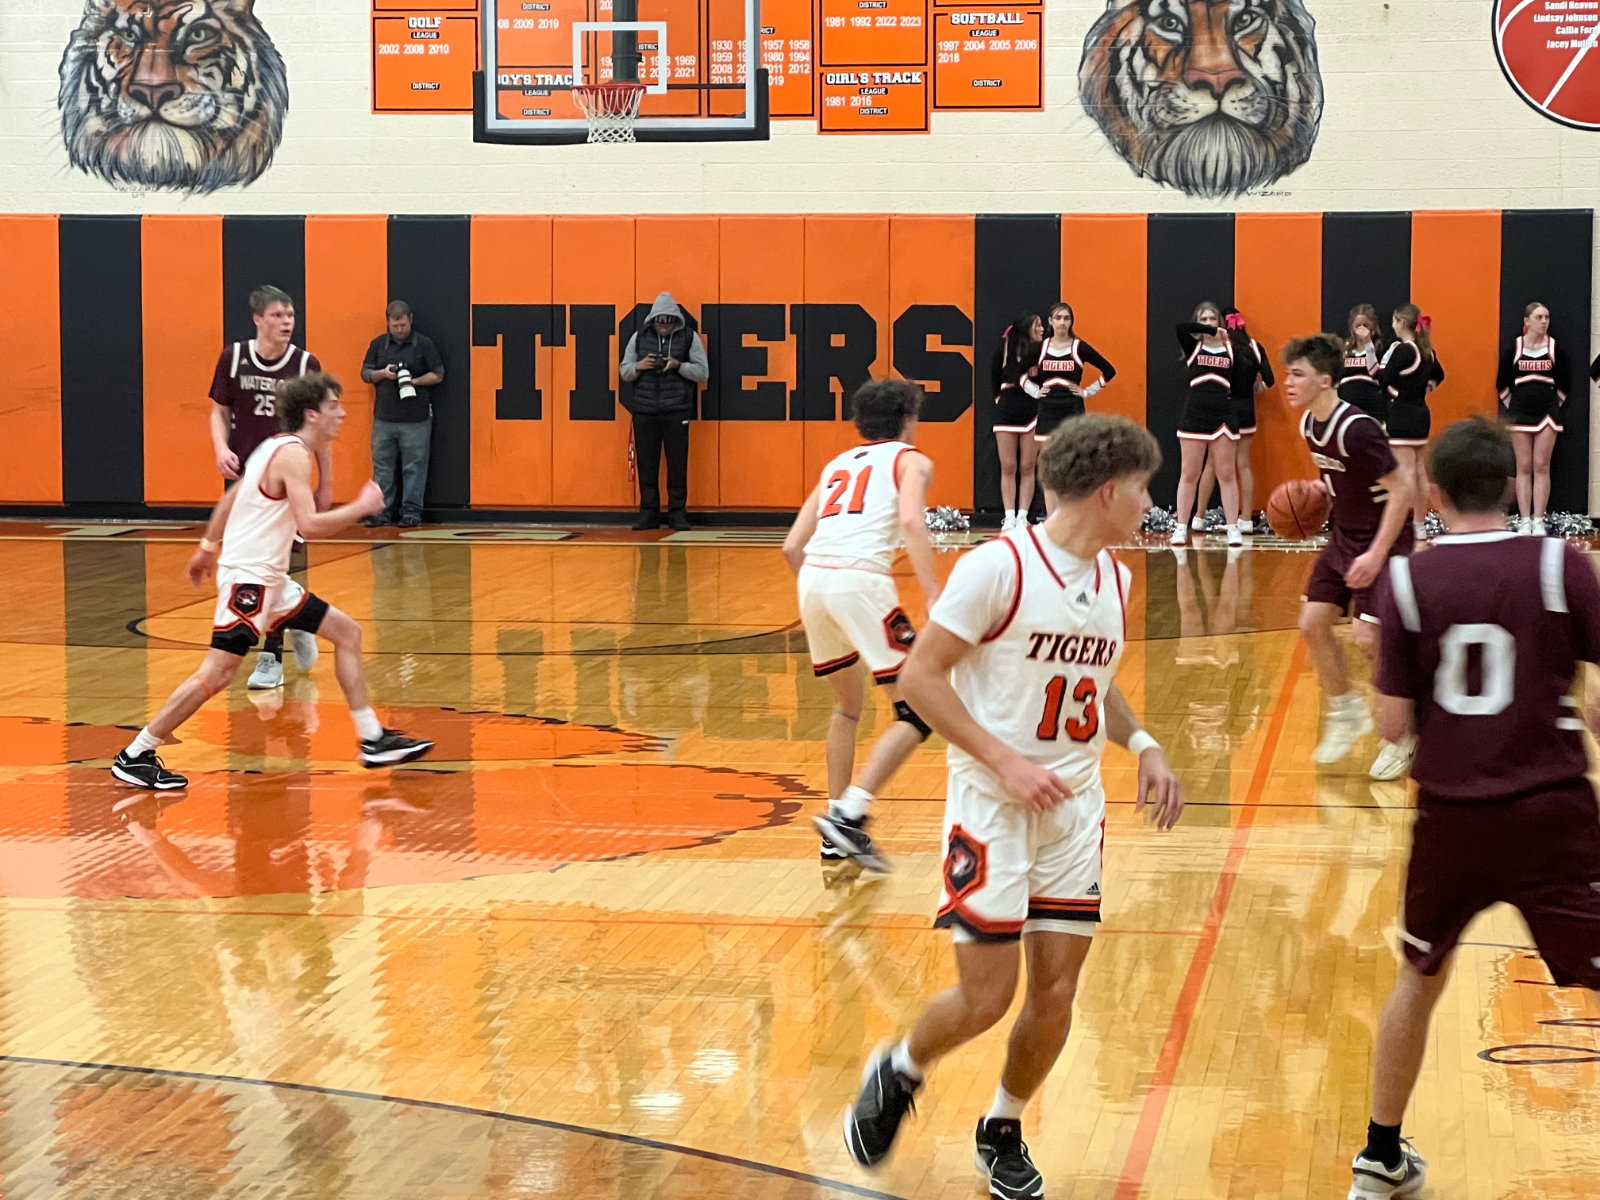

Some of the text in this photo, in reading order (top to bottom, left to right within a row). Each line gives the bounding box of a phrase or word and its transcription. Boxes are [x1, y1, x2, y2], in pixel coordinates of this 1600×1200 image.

[408, 17, 443, 28] GOLF
[513, 18, 534, 29] 2009
[538, 18, 560, 29] 2019
[825, 16, 922, 27] 1981 1992 2022 2023
[951, 12, 1024, 25] SOFTBALL
[1534, 13, 1598, 23] Lindsay Johnson
[971, 29, 997, 37] LEAGUE
[378, 43, 450, 54] 2002 2008 2010
[711, 40, 733, 50] 1930
[763, 39, 784, 50] 1957
[788, 39, 810, 50] 1958
[938, 39, 1037, 51] 1997 2004 2005 2006
[674, 55, 696, 66] 1969
[711, 52, 733, 62] 1959
[763, 52, 784, 62] 1980
[788, 52, 810, 62] 1994
[938, 52, 960, 63] 2018
[674, 67, 695, 78] 2021
[711, 64, 733, 74] 2008
[788, 64, 810, 74] 2012
[498, 74, 574, 85] OY'S TRAC
[711, 75, 733, 84] 2013
[768, 75, 784, 86] 019
[826, 72, 922, 84] GIRL'S TRACK
[973, 79, 1001, 87] DISTRICT
[412, 82, 439, 90] DISTRICT
[825, 96, 872, 107] 1981 2016
[860, 107, 888, 115] DISTRICT
[1042, 360, 1075, 371] TIGERS
[1197, 354, 1231, 368] TIGERS
[1344, 357, 1368, 367] TIGE
[1518, 360, 1553, 371] TIGERS
[254, 393, 276, 417] 25
[820, 465, 873, 519] 21
[1025, 632, 1117, 668] TIGERS
[1432, 623, 1517, 716] 0
[1036, 675, 1099, 742] 13
